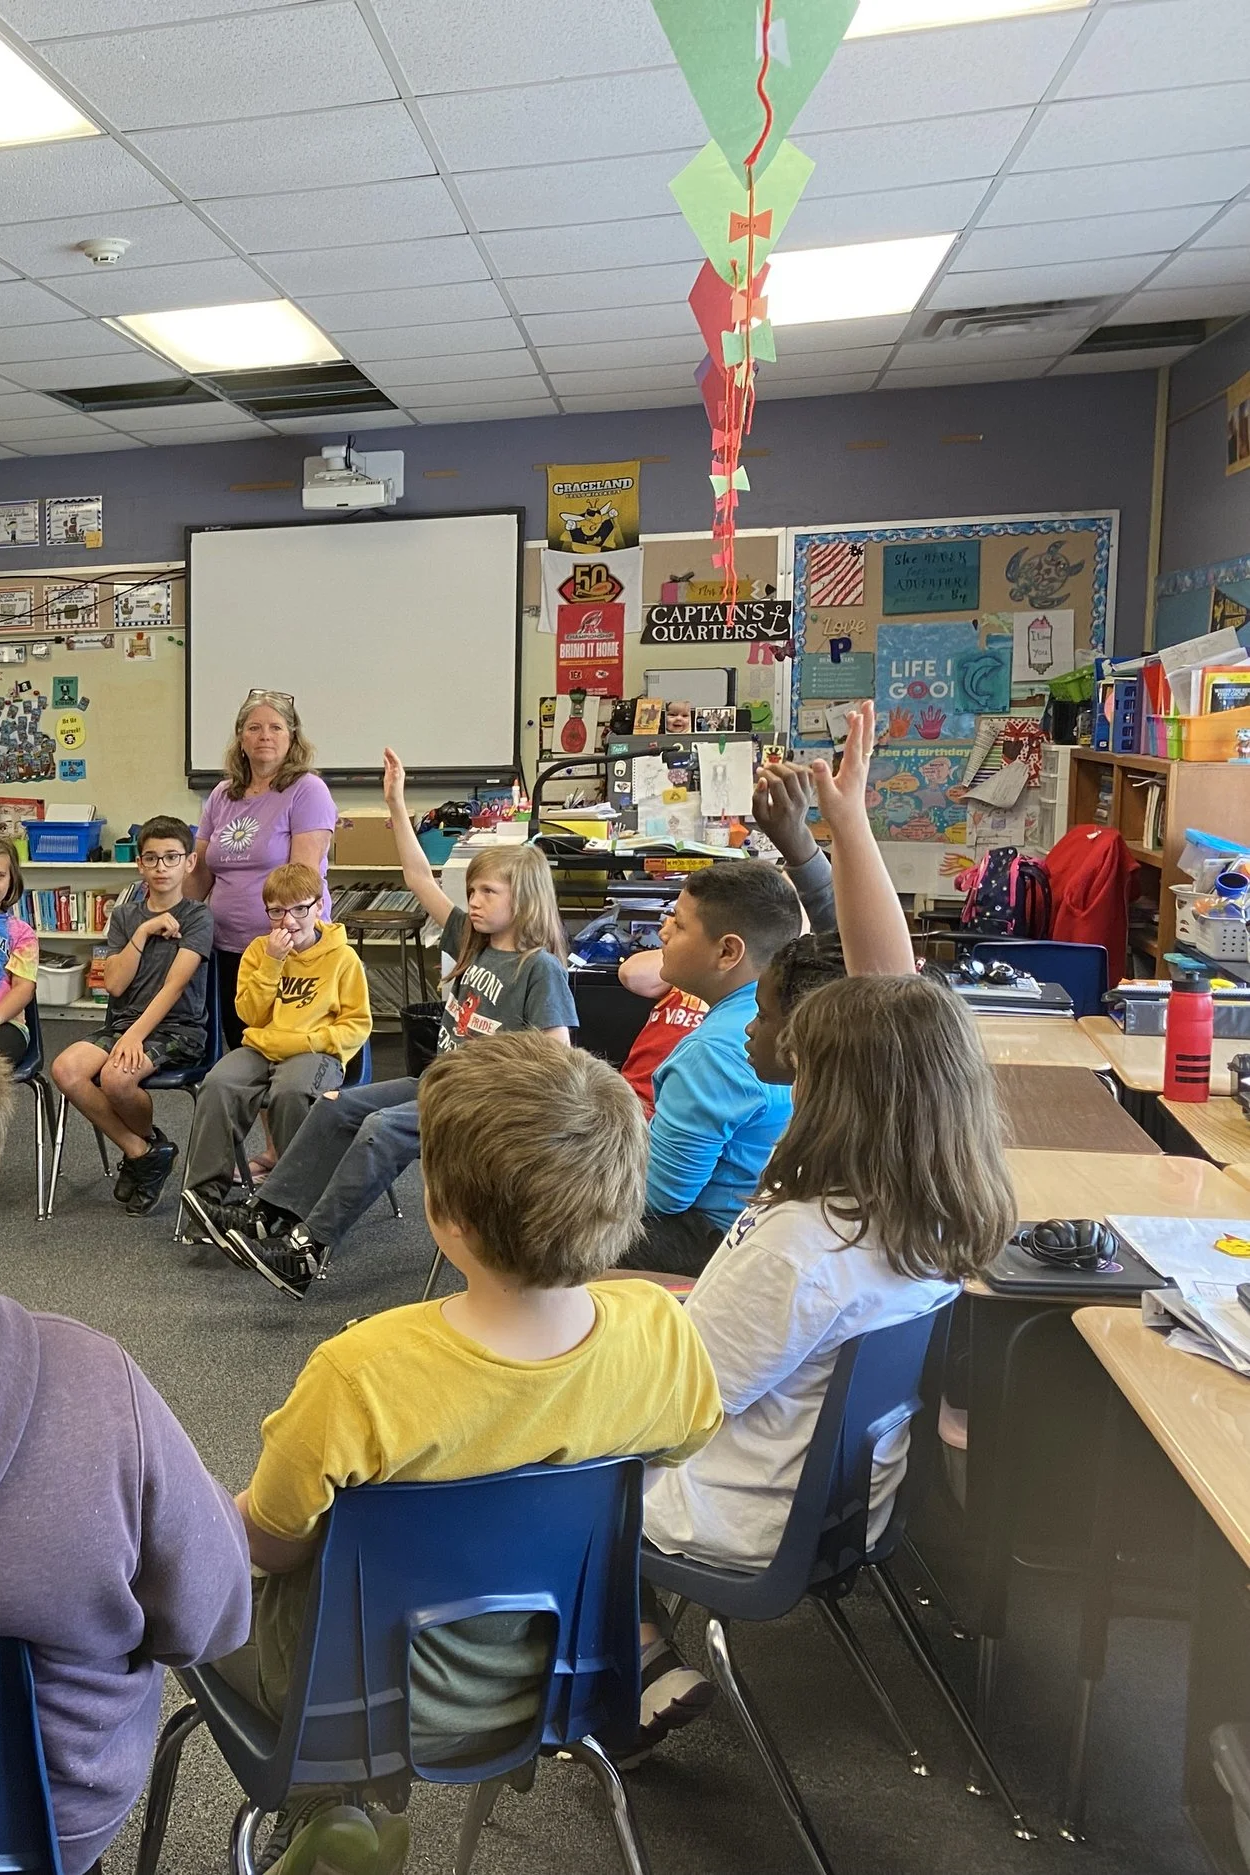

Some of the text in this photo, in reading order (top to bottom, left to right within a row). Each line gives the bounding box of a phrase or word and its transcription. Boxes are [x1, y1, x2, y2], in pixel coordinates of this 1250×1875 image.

[553, 477, 633, 495] GRACELAND
[651, 603, 766, 625] CAPTAIN'S
[651, 623, 759, 642] QUARTERS
[822, 617, 867, 636] Love
[560, 641, 620, 658] BRING IT HOME
[829, 637, 852, 664] P
[891, 660, 937, 678] LIFE
[889, 681, 954, 699] GOO
[879, 748, 900, 757] Sea
[902, 748, 915, 757] of
[460, 964, 504, 1007] AMONI
[471, 1016, 495, 1034] PRIDE
